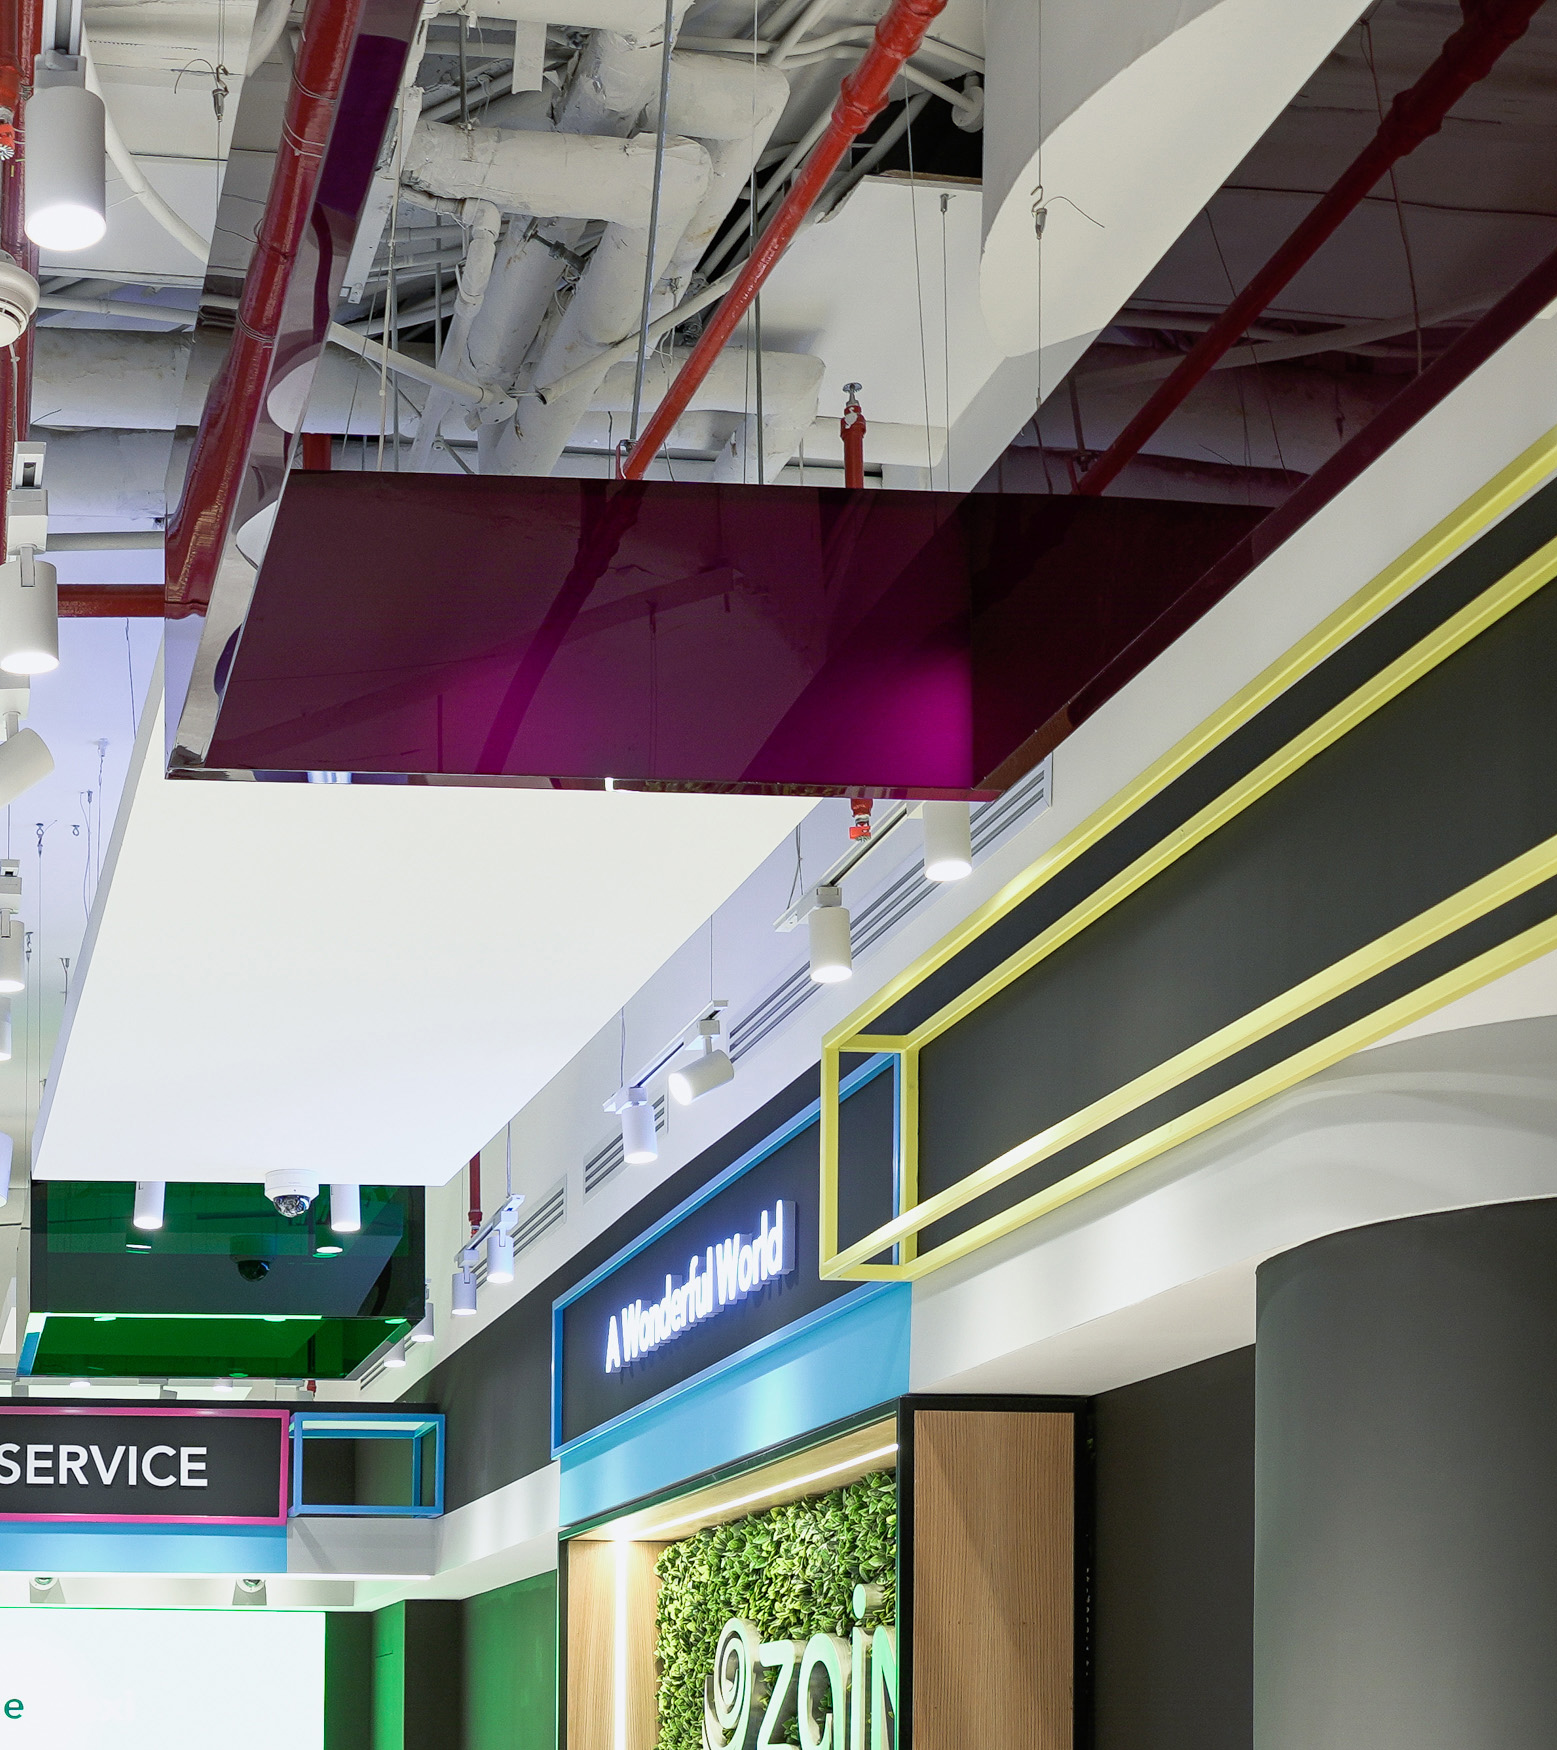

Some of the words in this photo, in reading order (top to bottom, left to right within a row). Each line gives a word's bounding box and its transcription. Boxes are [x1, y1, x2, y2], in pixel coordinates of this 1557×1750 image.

[604, 1312, 623, 1374] A
[622, 1240, 716, 1362] Wonderful
[714, 1199, 784, 1309] World
